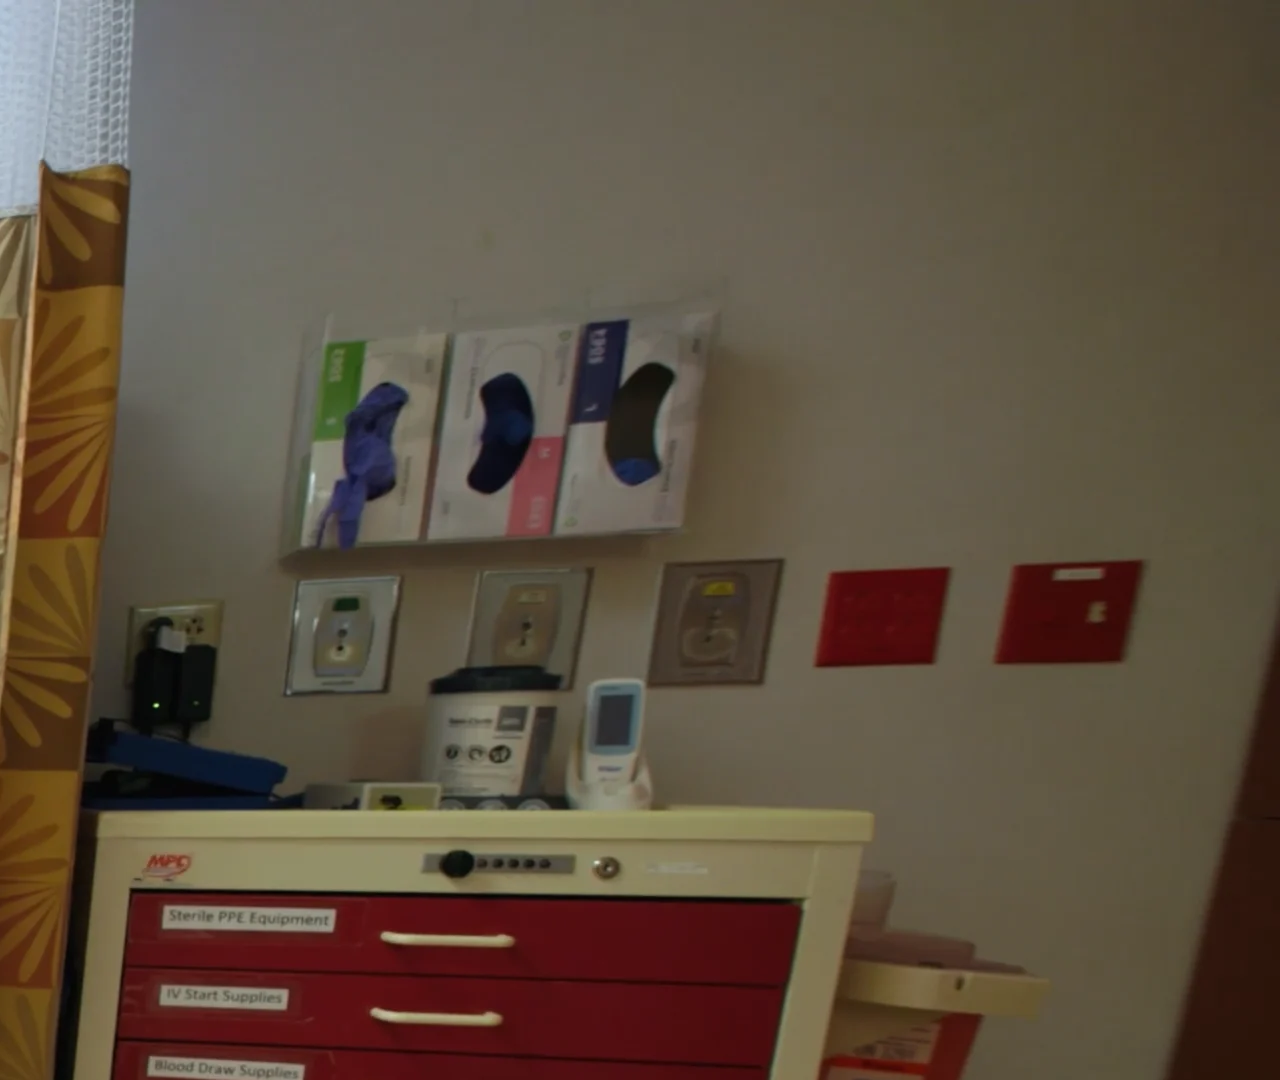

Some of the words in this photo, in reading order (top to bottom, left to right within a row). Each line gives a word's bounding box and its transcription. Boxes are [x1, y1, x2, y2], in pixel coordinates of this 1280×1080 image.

[169, 909, 214, 923] Sterile
[218, 911, 245, 924] PPE
[249, 912, 329, 928] Equipment
[167, 988, 181, 999] IV
[185, 989, 218, 1000] Start
[223, 991, 282, 1005] Supplies
[155, 1060, 194, 1072] Blood
[198, 1063, 236, 1075] Draw
[240, 1064, 299, 1079] Supplies
